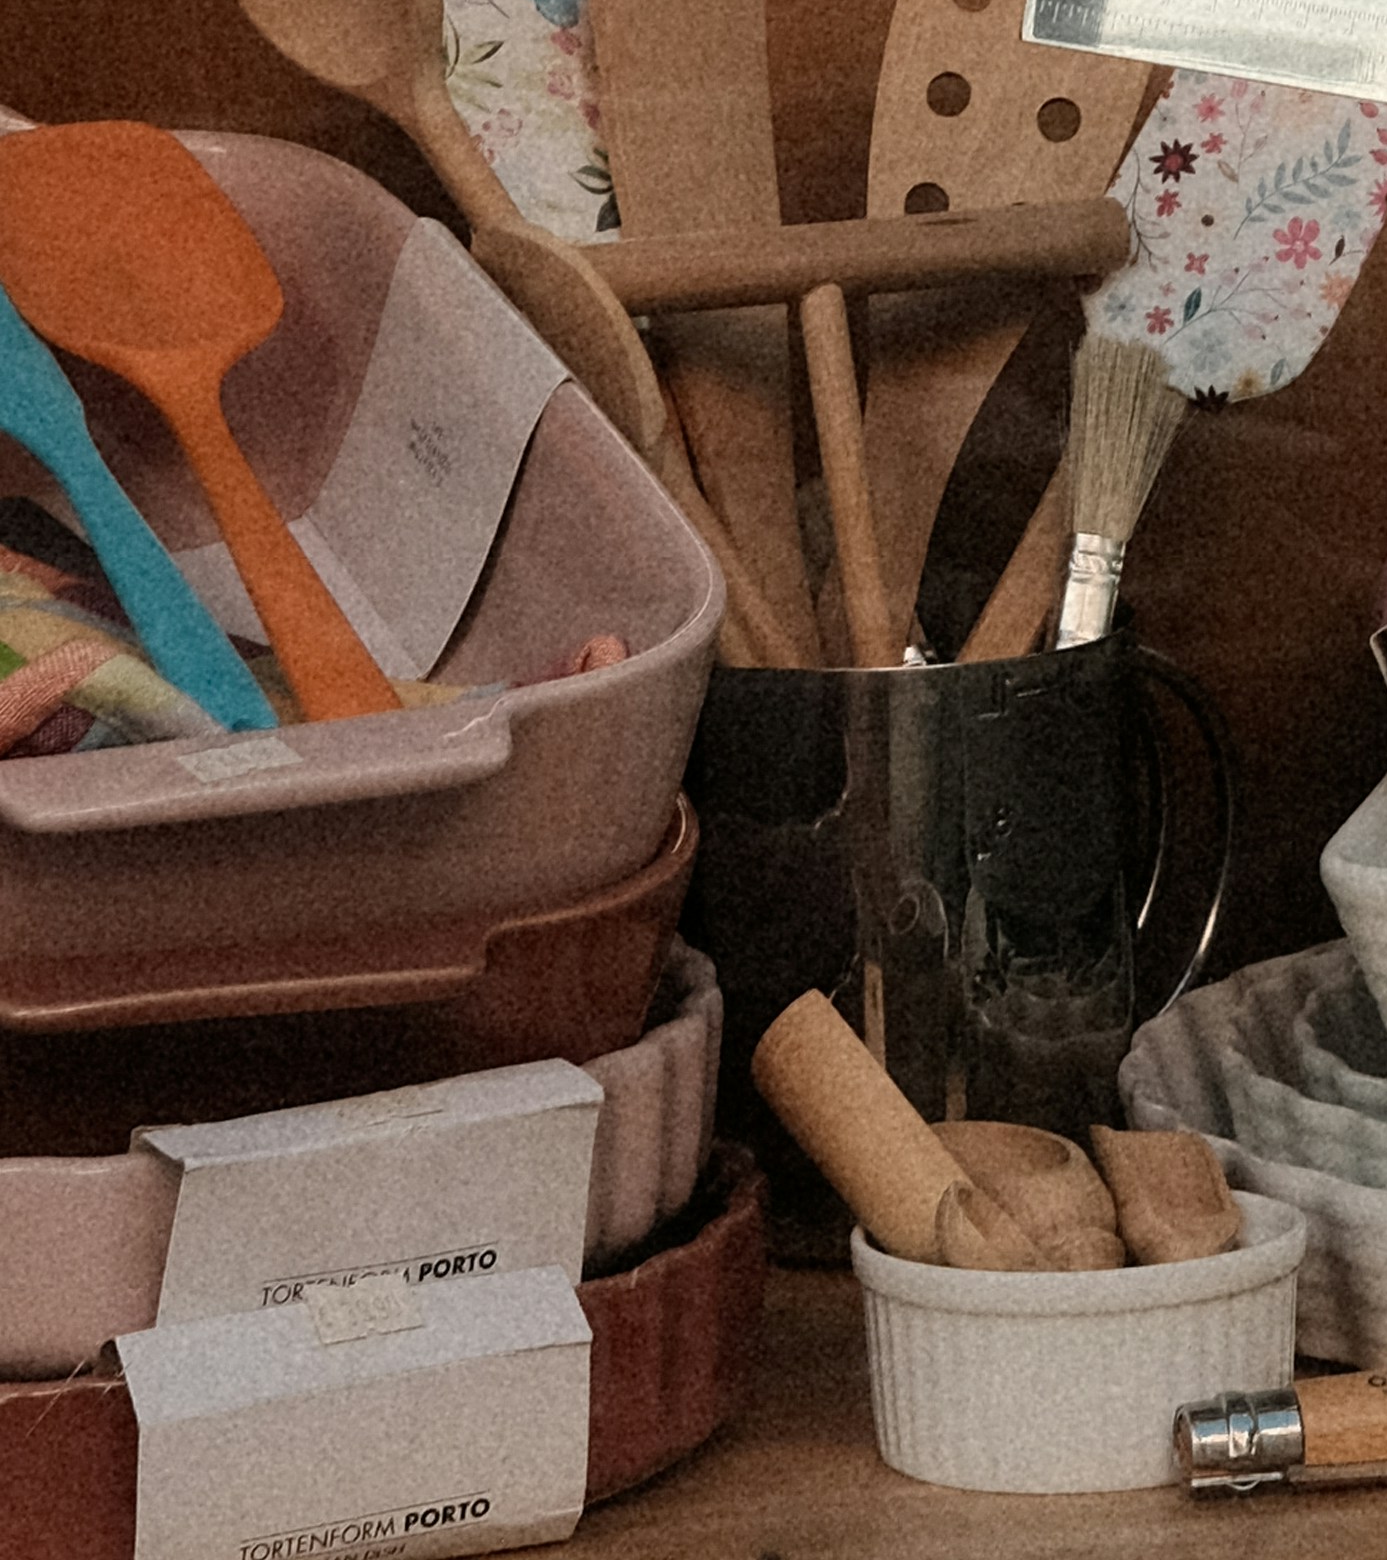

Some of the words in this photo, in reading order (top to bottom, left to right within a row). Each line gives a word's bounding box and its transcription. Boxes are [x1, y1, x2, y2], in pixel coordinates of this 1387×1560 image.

[418, 1249, 497, 1282] PORTO
[239, 1517, 396, 1560] TORTENFORM
[403, 1498, 491, 1532] PORTO
